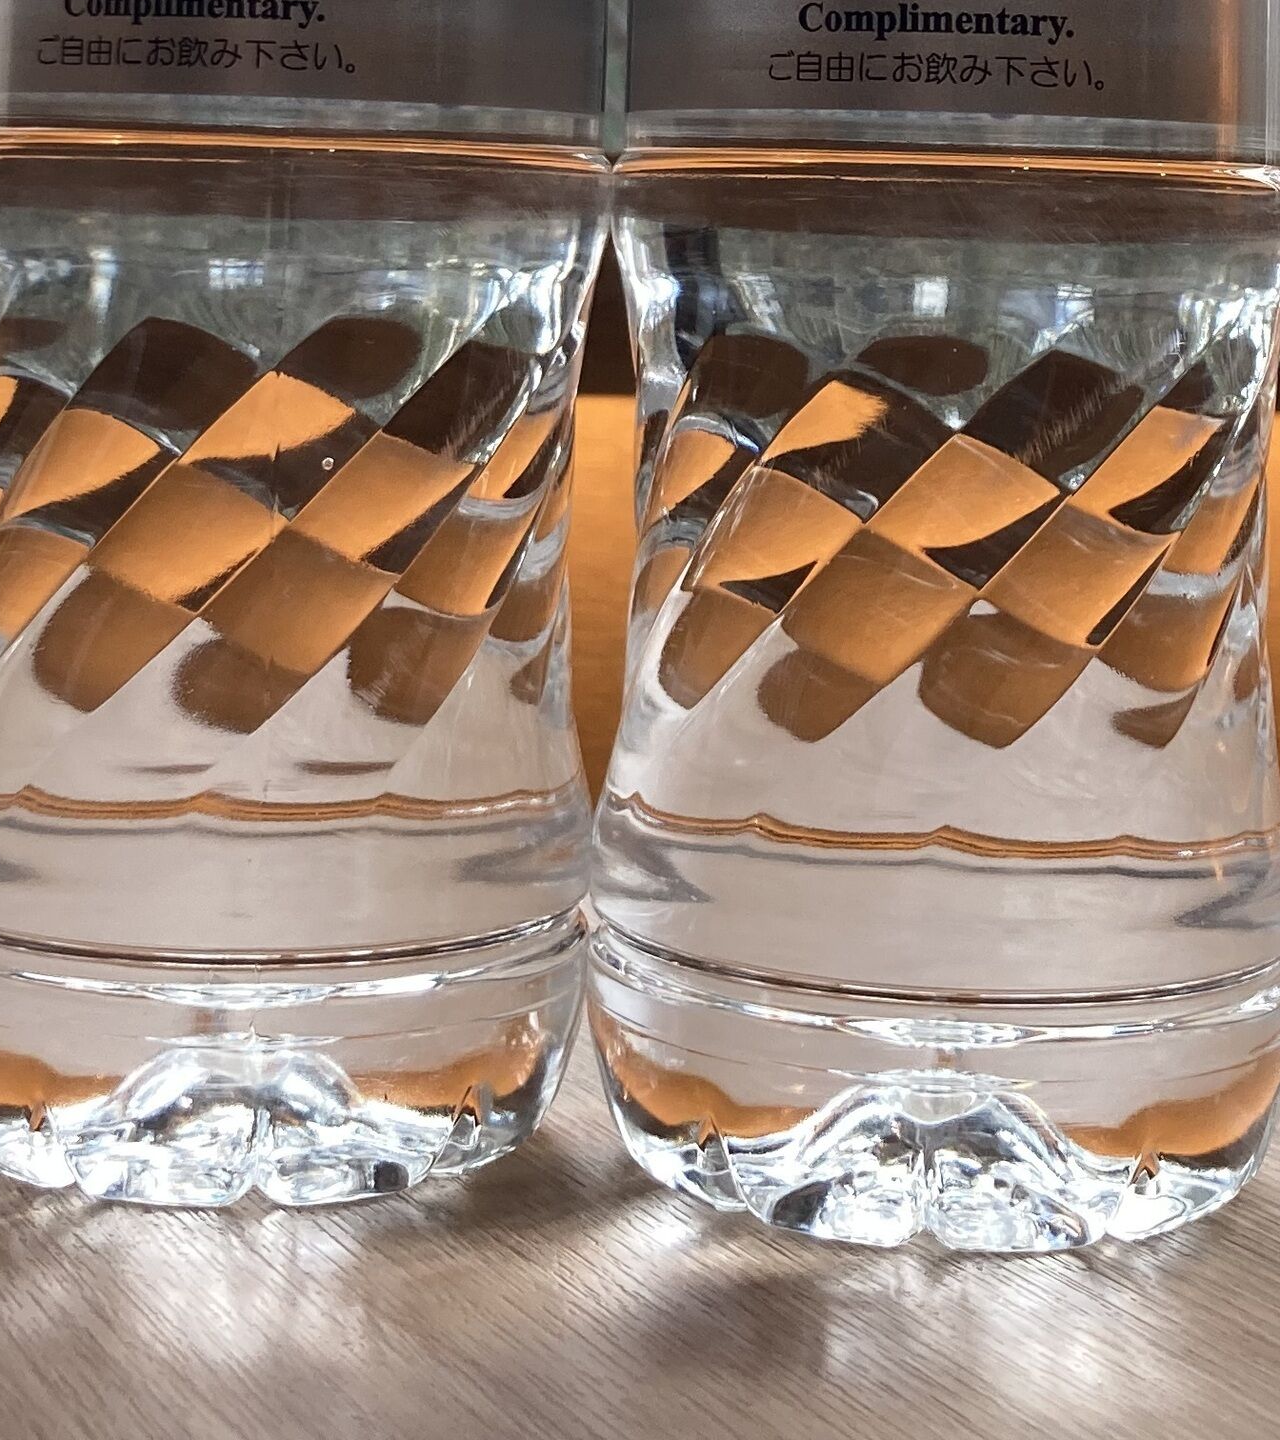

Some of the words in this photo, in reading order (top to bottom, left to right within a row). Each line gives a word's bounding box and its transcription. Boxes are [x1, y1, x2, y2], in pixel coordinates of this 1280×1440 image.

[798, 1, 1075, 42] Complimentary.
[36, 33, 357, 74] ご自由にお飲み下さい。
[768, 51, 1106, 91] ご自由にお飲み下さい。
